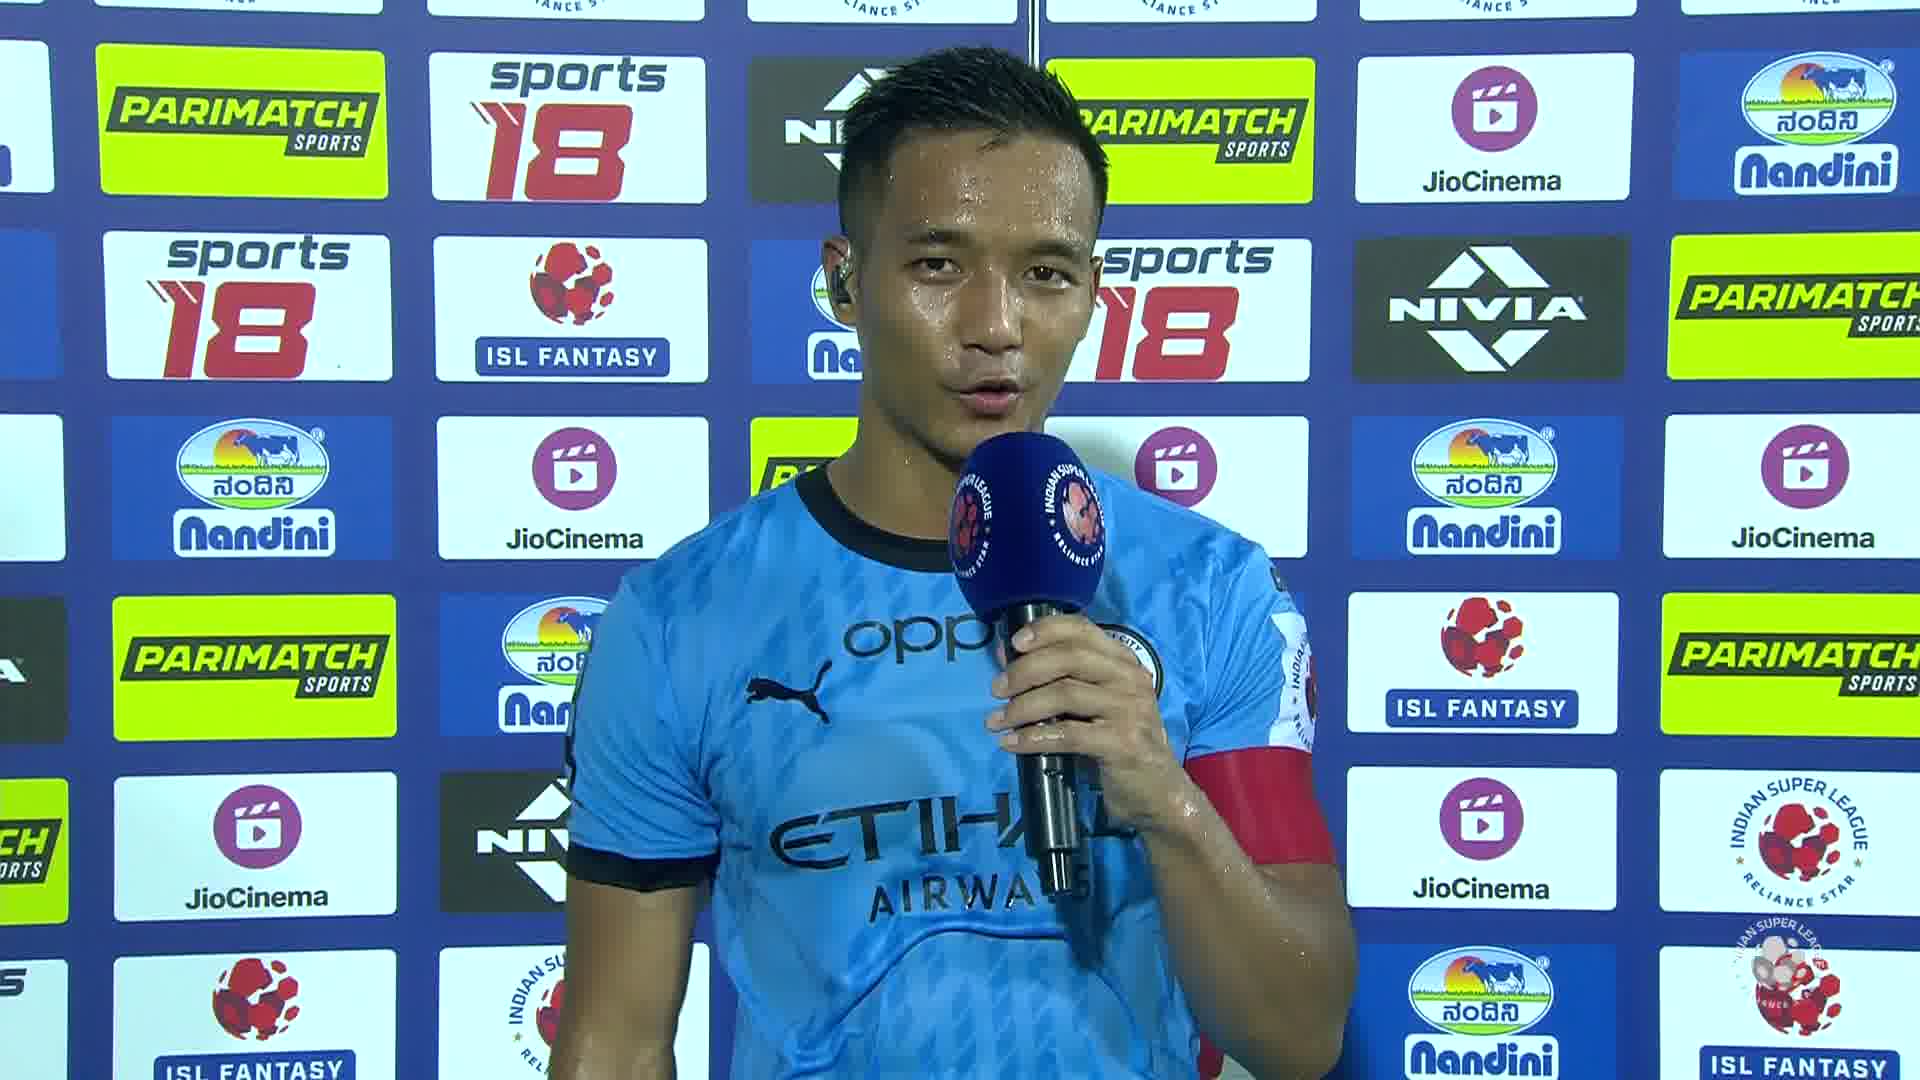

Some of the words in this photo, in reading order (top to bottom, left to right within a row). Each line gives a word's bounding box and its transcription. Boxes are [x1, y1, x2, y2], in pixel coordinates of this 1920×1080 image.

[490, 56, 667, 97] sports
[119, 94, 368, 129] PARIMATCH
[1777, 109, 1858, 133] ನಂದಿನಿ
[294, 133, 362, 152] SPORTS
[470, 102, 634, 201] 18
[1225, 141, 1290, 158] SPORTS
[1422, 170, 1561, 193] JioCinema
[1739, 152, 1892, 189] Nandini
[167, 233, 350, 276] sports
[1102, 240, 1274, 281] sports
[1389, 297, 1588, 322] NIVIA
[147, 279, 316, 378] 18
[1095, 286, 1239, 381] 18
[486, 347, 530, 368] ISL
[538, 347, 658, 369] FANTASY
[213, 474, 294, 497] ನಂದಿನಿ
[1446, 473, 1522, 497] ನಂದಿನಿ
[974, 476, 992, 520] LEAGUE
[179, 516, 329, 551] Nandini
[506, 528, 644, 550] JioCinema
[1412, 514, 1556, 549] Nandini
[1731, 526, 1875, 550] JioCinema
[843, 615, 996, 664] opp
[134, 642, 377, 672] PARIMATCH
[1681, 641, 1920, 669] PARIMATCH
[303, 676, 372, 695] SPORTS
[1848, 675, 1918, 691] SPORTS
[1396, 698, 1437, 718] ISL
[1447, 698, 1568, 719] FANTASY
[1730, 790, 1767, 848] INDIAN
[1768, 777, 1827, 797] SUPER
[1828, 788, 1868, 850] LEAGUE
[0, 861, 42, 878] ORTS
[185, 887, 329, 911] JioCinema
[1412, 878, 1550, 900] JioCinema
[1744, 872, 1814, 907] RELIANCE
[1820, 875, 1855, 903] STAR
[508, 965, 545, 1024] INDIAN
[1443, 1002, 1519, 1022] ನಂದಿನಿ
[166, 1064, 208, 1080] ISL
[220, 1060, 343, 1080] FANTASY
[1410, 1040, 1553, 1076] Nandini
[1711, 1056, 1752, 1075] ISL
[1763, 1057, 1887, 1079] FANTASY
